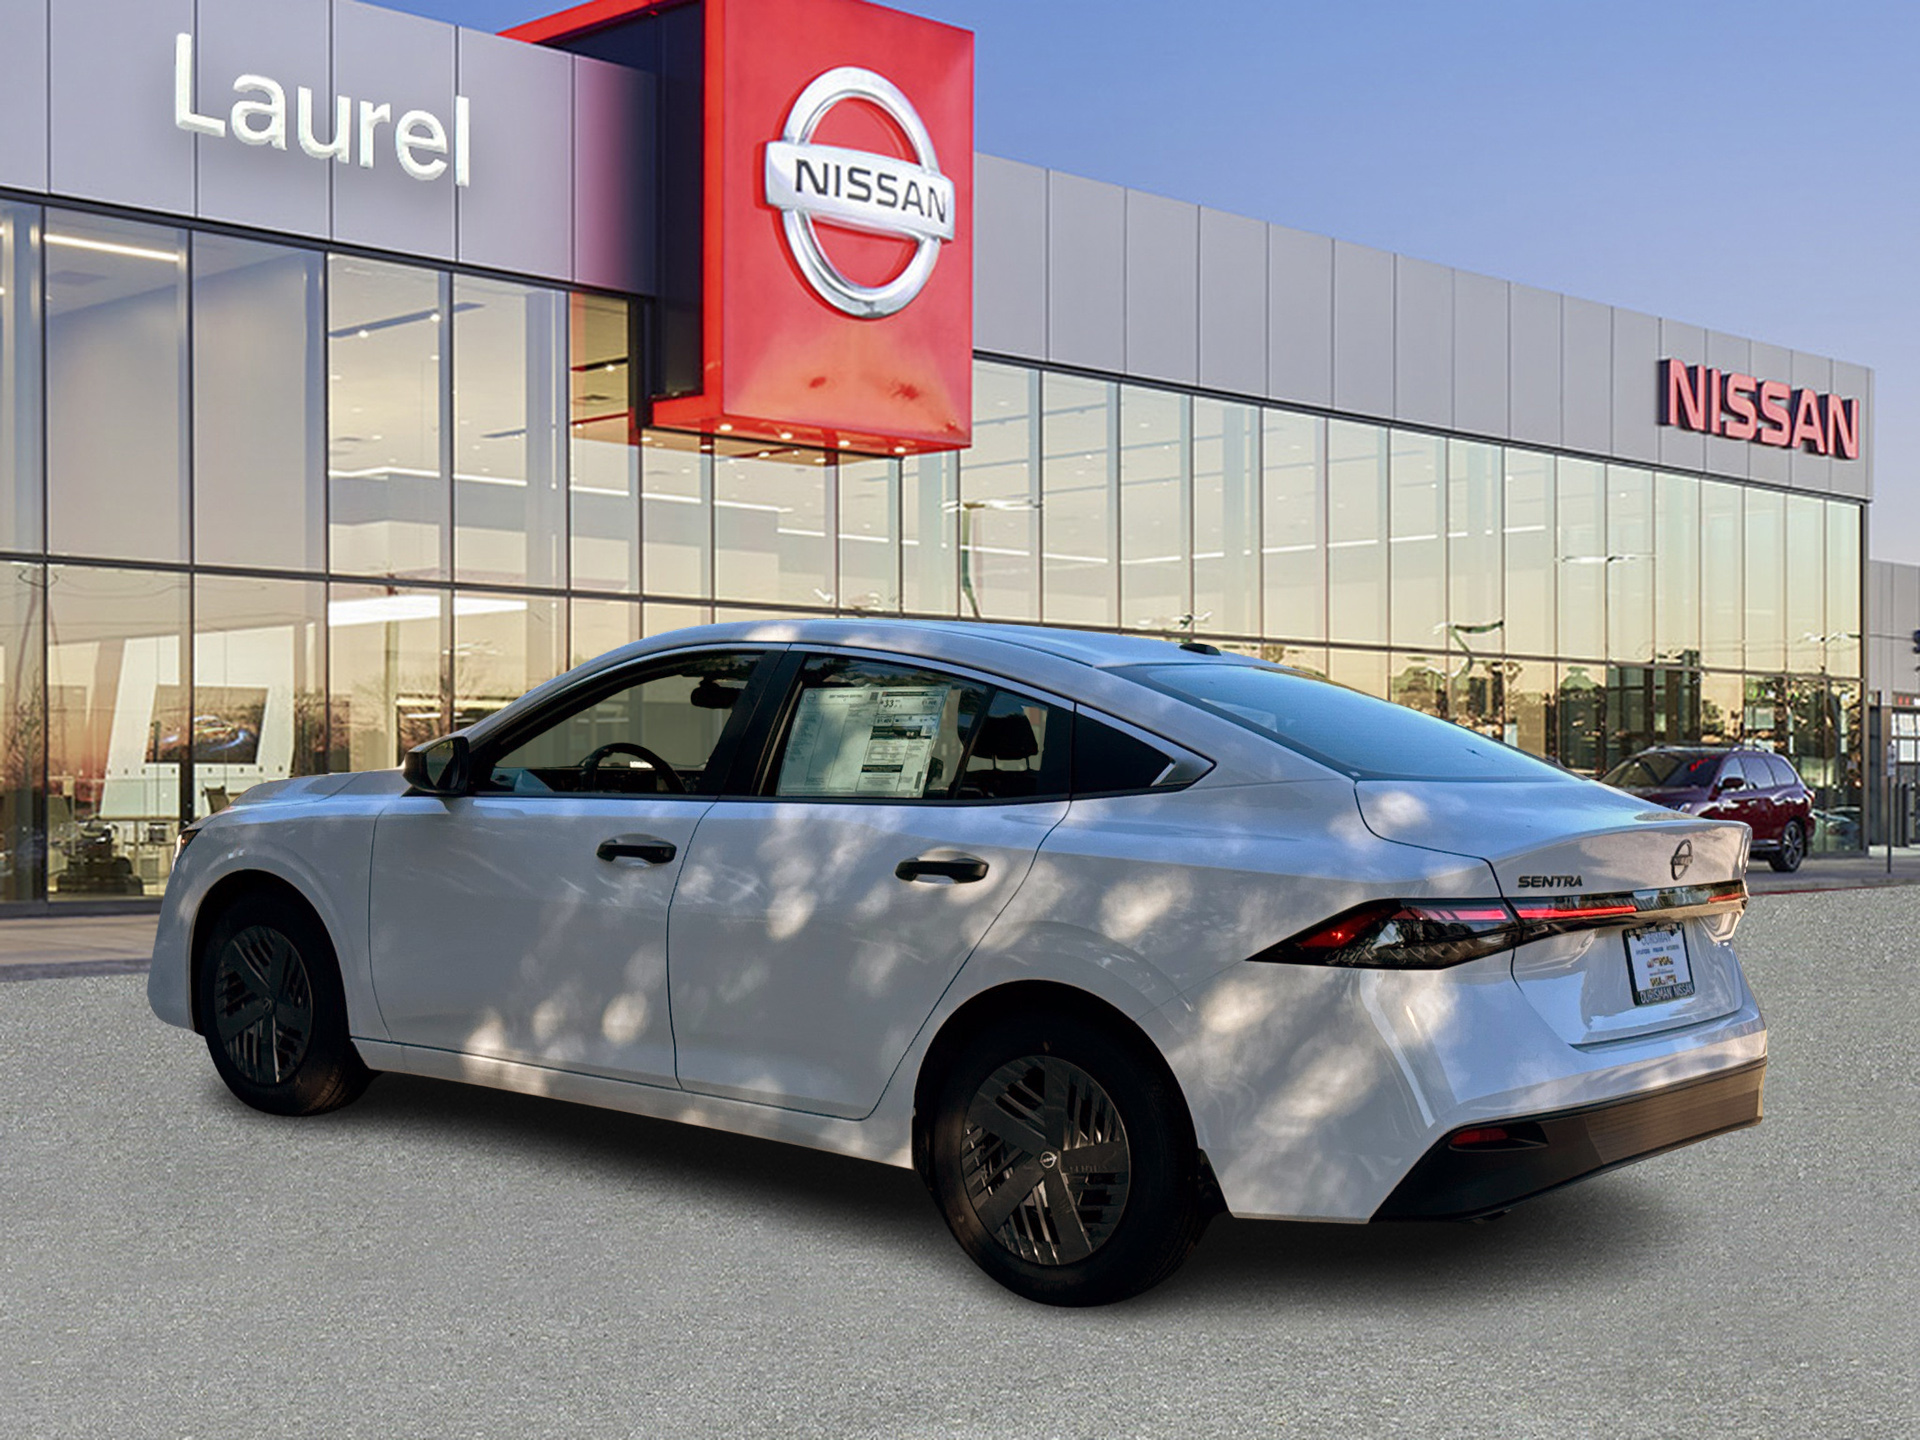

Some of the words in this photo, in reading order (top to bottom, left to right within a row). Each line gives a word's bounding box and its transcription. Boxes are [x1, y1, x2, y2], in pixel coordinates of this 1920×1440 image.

[175, 32, 470, 188] Laurel
[794, 158, 947, 224] NISSAN
[1660, 357, 1860, 460] NISSAN
[1517, 874, 1583, 888] SENTRA
[1640, 986, 1673, 1004] OURISMAN
[1673, 981, 1694, 997] NISSAN
